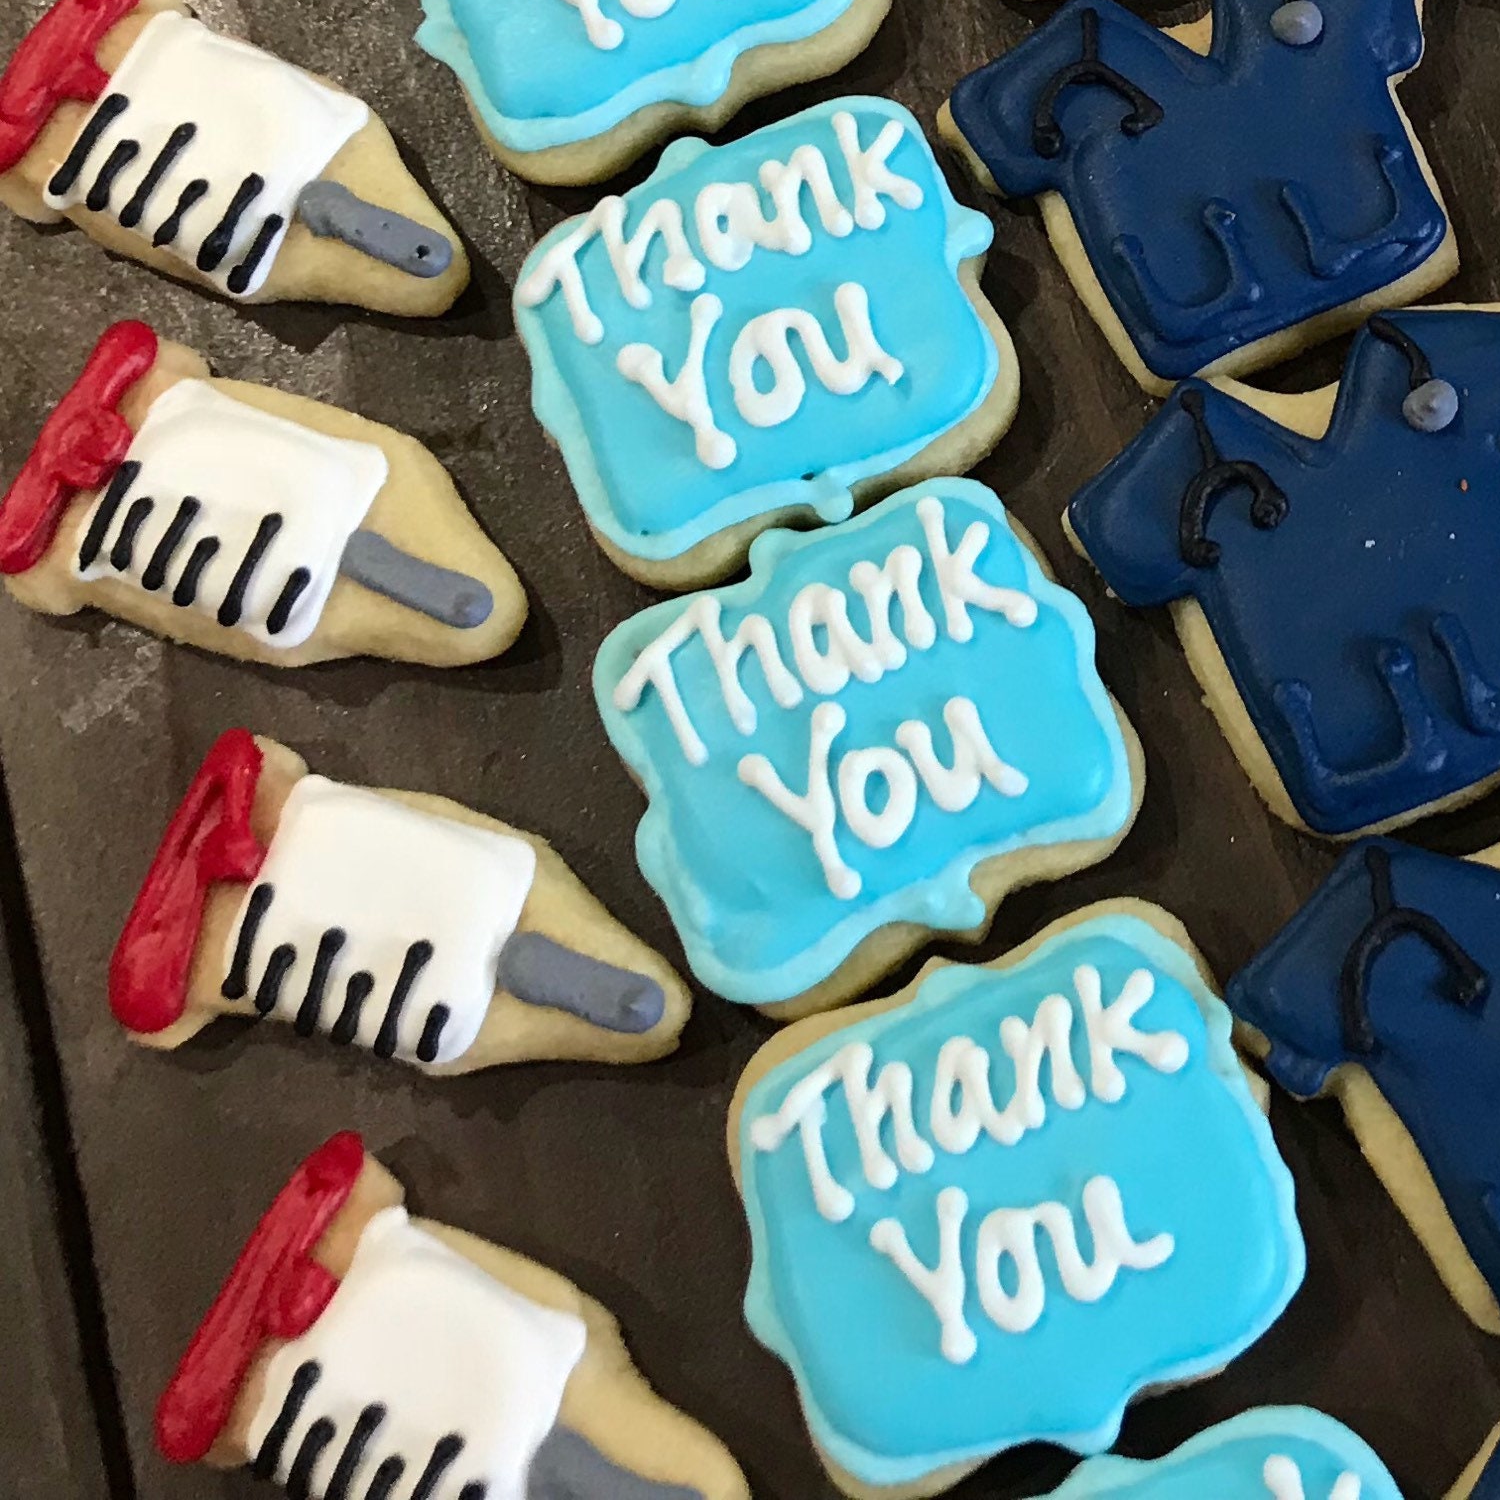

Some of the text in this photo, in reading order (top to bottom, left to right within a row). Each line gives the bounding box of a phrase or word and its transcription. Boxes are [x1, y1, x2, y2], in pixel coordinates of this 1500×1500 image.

[516, 112, 922, 342] Thank
[617, 283, 902, 468] You
[614, 497, 1036, 763] Thank
[738, 697, 1027, 899] You
[753, 965, 1187, 1220] Thank
[870, 1176, 1173, 1363] You
